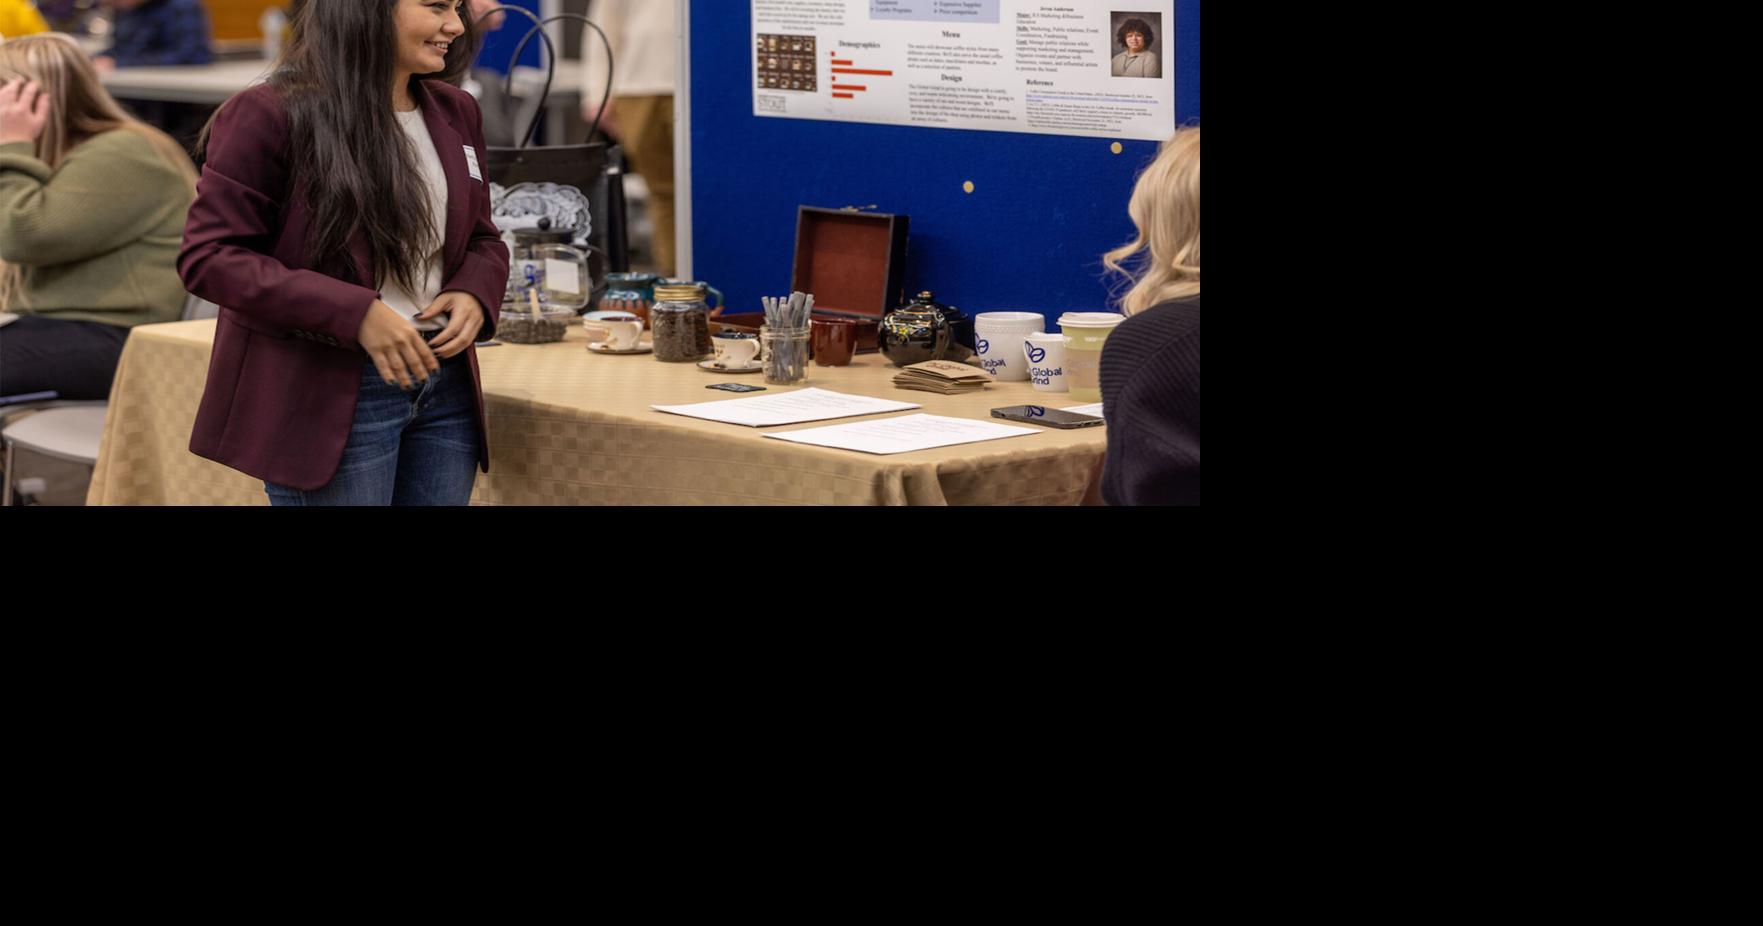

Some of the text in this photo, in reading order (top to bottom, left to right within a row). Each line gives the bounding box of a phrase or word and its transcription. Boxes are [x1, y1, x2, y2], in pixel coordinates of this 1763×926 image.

[942, 30, 960, 38] Menu
[838, 40, 881, 50] Demographics
[941, 73, 963, 83] Design
[1026, 79, 1053, 87] Reference
[981, 359, 1006, 367] lobal
[1032, 367, 1062, 376] Global
[1032, 377, 1050, 385] rind
